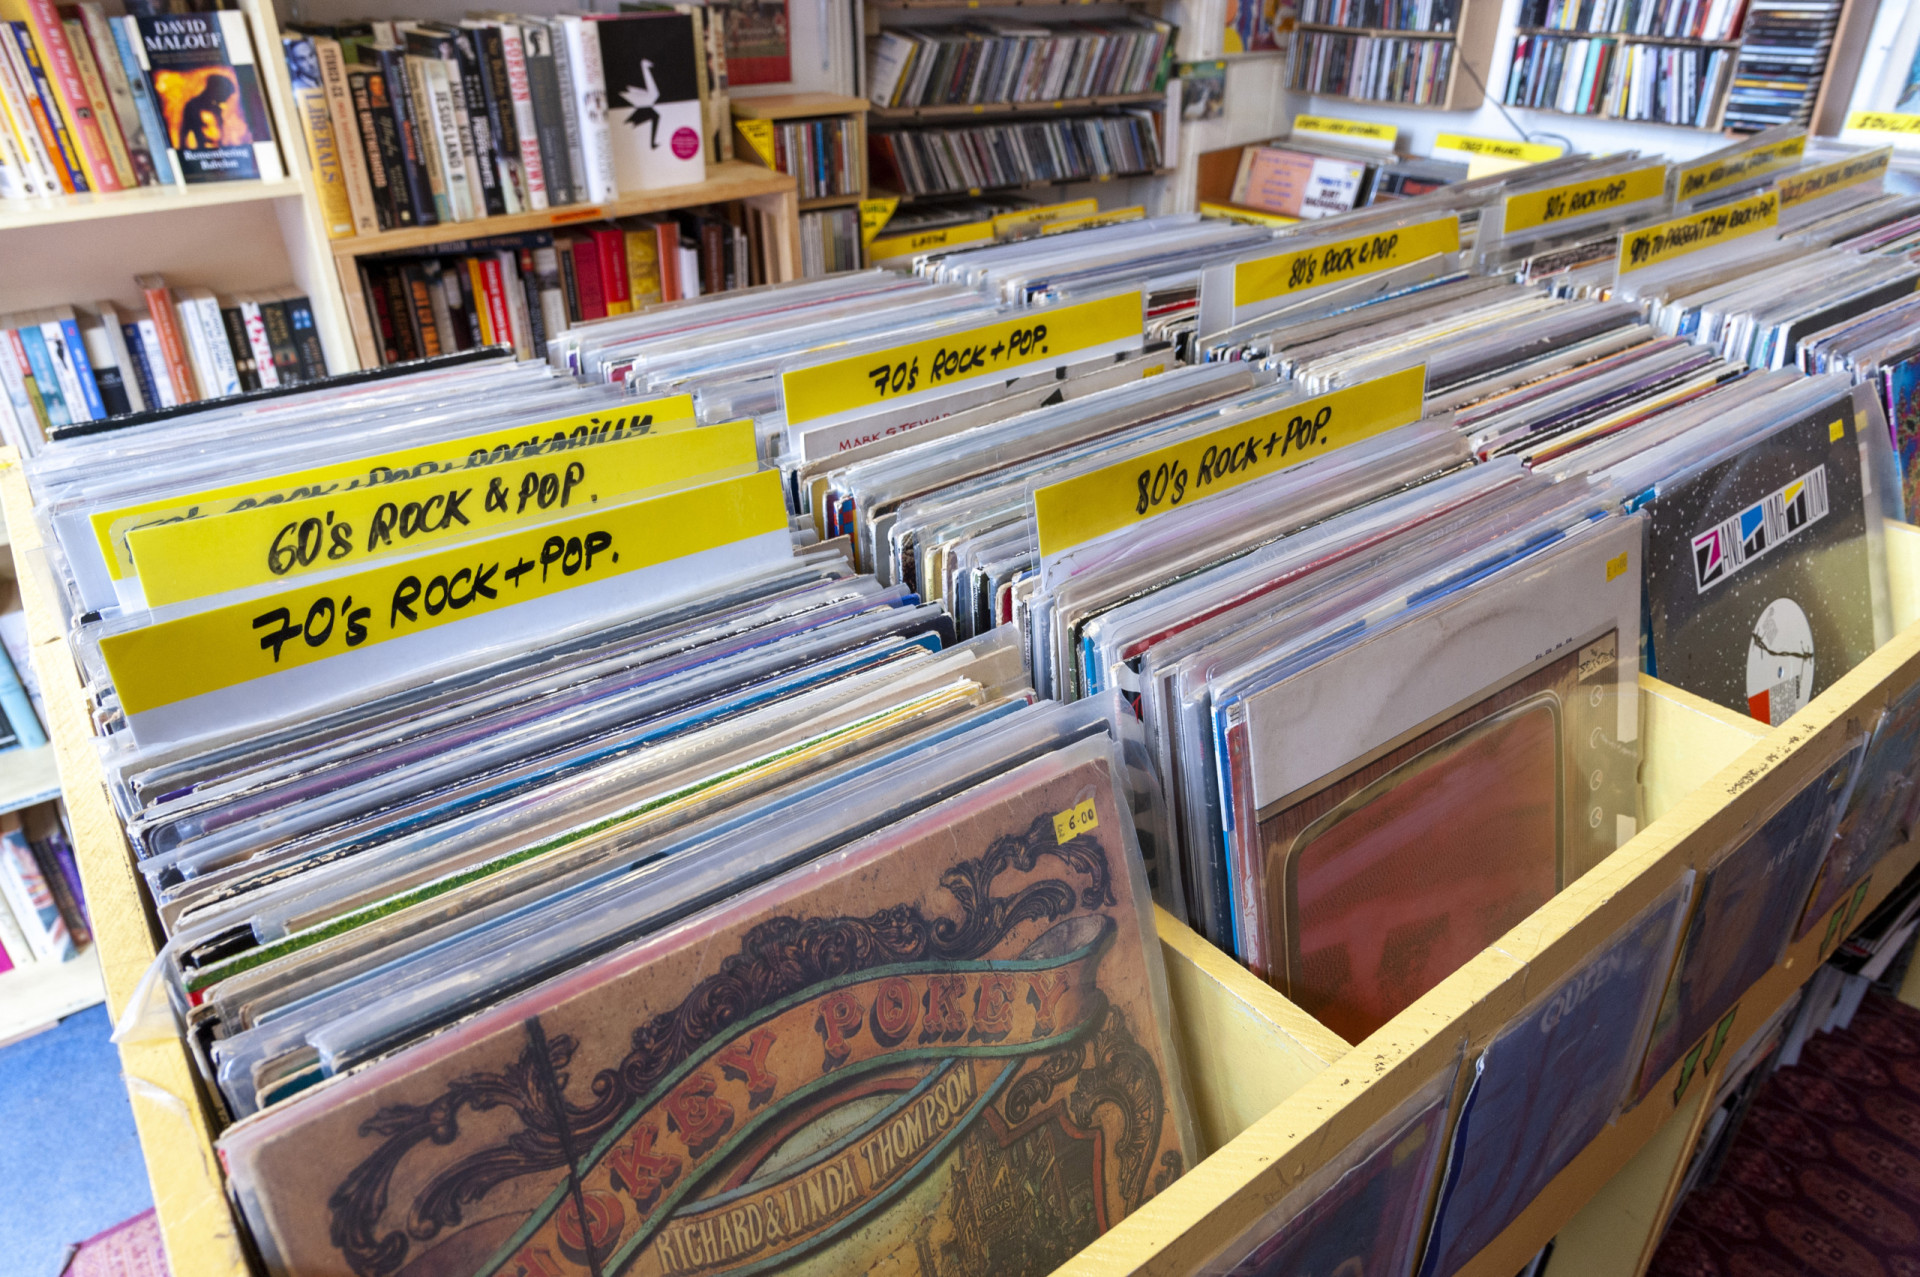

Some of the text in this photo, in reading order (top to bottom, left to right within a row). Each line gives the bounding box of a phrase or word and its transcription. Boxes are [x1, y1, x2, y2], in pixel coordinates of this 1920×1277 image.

[144, 33, 222, 51] MALOUF
[154, 19, 207, 35] DAVID
[504, 38, 530, 101] GORDON
[436, 90, 453, 132] JESUS
[183, 148, 249, 162] Remembering
[305, 93, 336, 183] LIBERALS
[200, 159, 239, 171] Babylon
[521, 139, 545, 192] BROWN
[1320, 248, 1357, 276] ROCK
[839, 413, 951, 451] MARK STEW
[367, 488, 473, 552] ROCK
[484, 477, 509, 514] &
[490, 973, 1070, 1277] OKEY POKEY
[861, 1062, 977, 1189] THOMPSON
